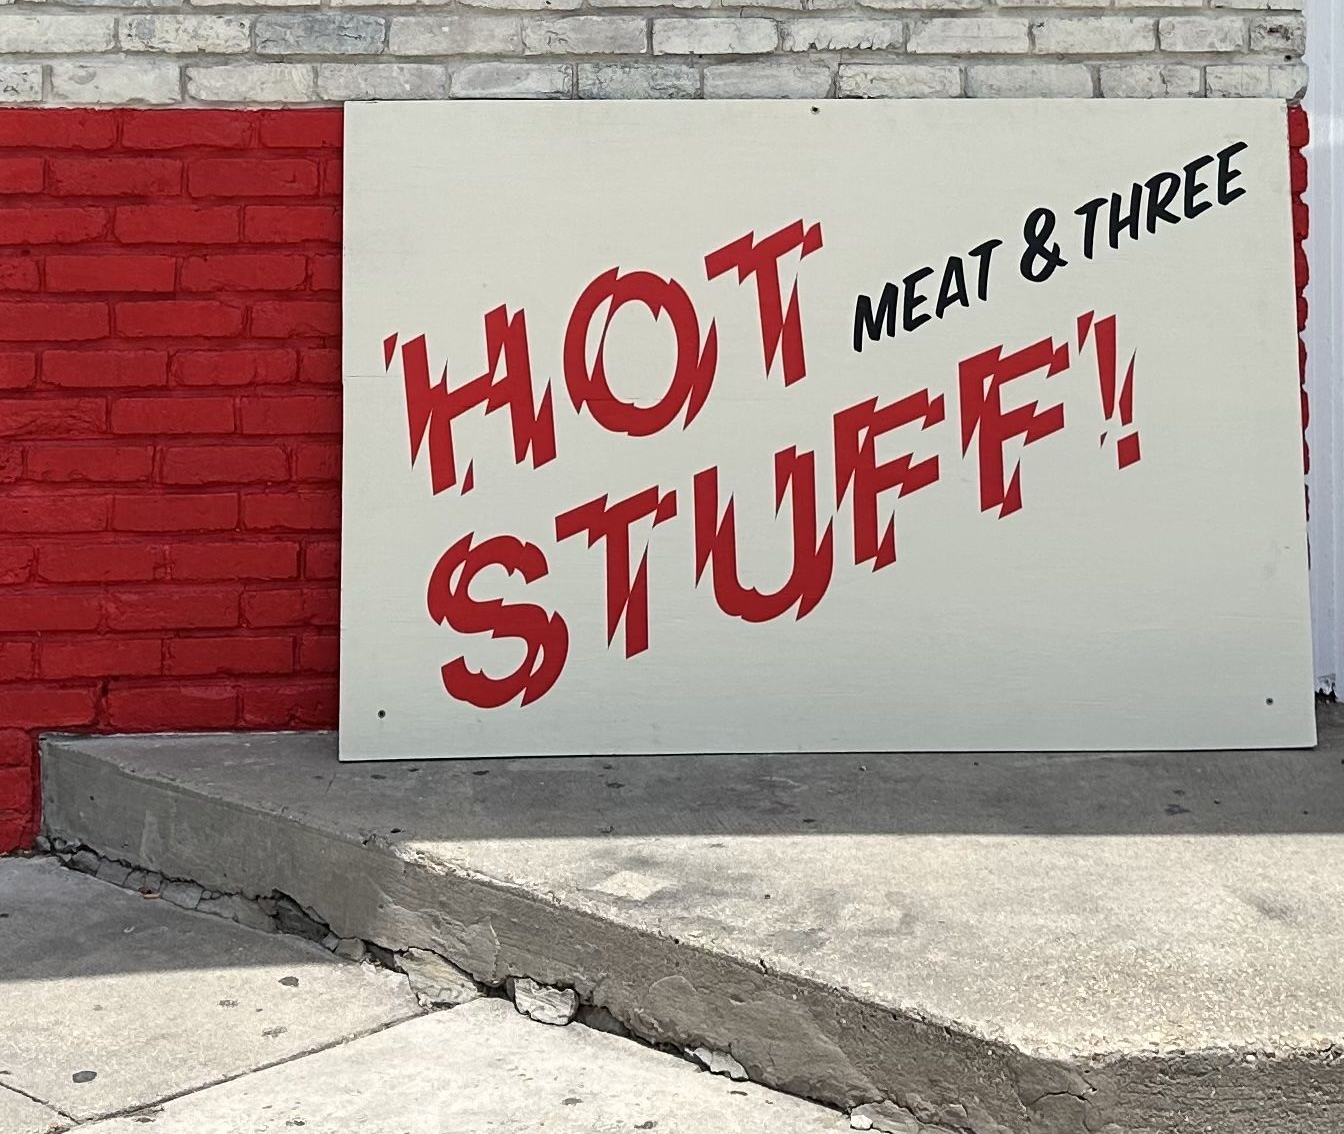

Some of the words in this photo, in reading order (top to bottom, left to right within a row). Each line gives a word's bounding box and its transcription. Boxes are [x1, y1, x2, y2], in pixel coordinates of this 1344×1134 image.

[383, 219, 824, 495] HOT
[853, 238, 1003, 353] MEAT
[1018, 206, 1070, 284] &
[1073, 141, 1249, 261] THREE
[426, 310, 1141, 709] STUFF!
